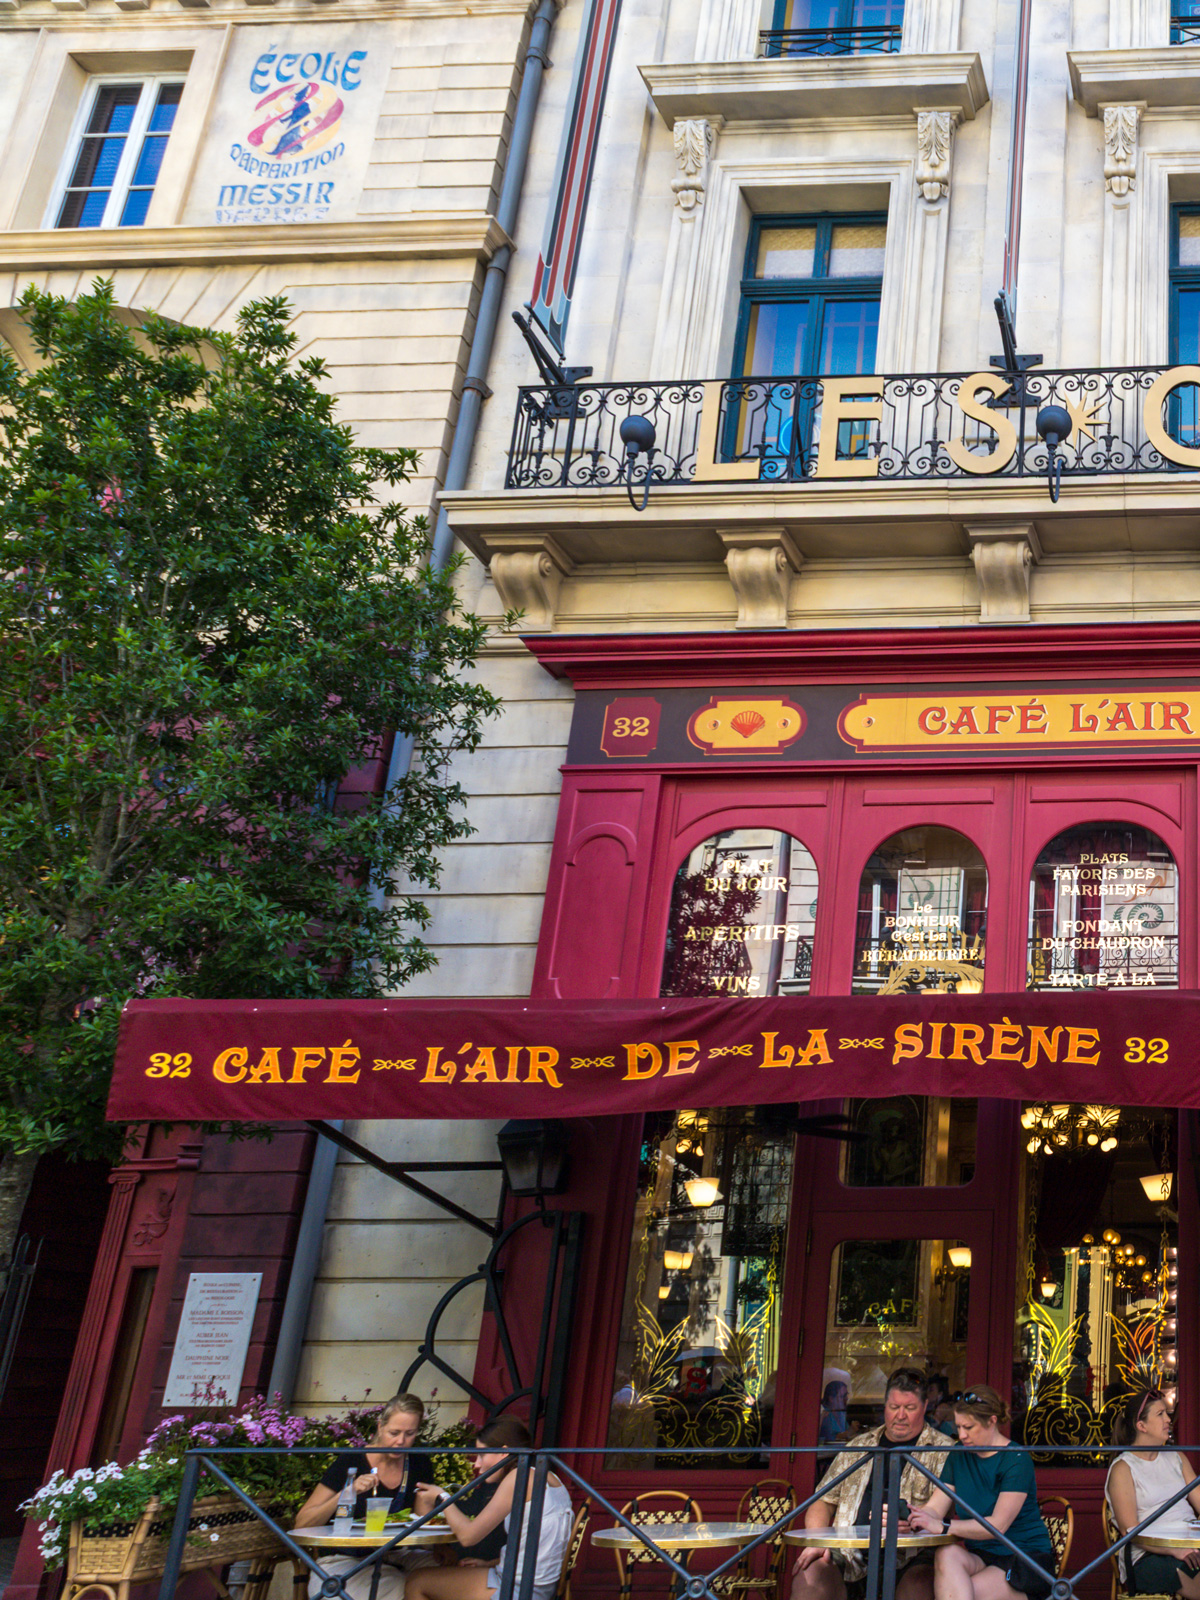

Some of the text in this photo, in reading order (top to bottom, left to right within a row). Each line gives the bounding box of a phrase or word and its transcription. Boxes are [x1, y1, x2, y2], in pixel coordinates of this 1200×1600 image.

[250, 44, 368, 94] ÉCOLE
[690, 373, 1018, 482] LES
[918, 698, 1048, 736] CAFÉ
[1069, 699, 1196, 736] L'AIR
[612, 716, 650, 738] 32
[722, 859, 773, 874] PLAT
[1080, 853, 1129, 865] PLATS
[1052, 868, 1155, 881] FAVORIS DES
[704, 876, 788, 892] DU JOUR
[1060, 884, 1147, 897] PARISIENS
[913, 902, 932, 913] Le
[885, 915, 960, 929] BONHEUR
[1062, 920, 1145, 934] FONDANT
[683, 924, 800, 943] APÉRITIFS
[928, 930, 947, 941] La
[1042, 936, 1165, 951] DU CHAUDRON
[712, 976, 760, 993] VINS
[1048, 971, 1156, 988] TARTE À LA
[145, 1017, 1170, 1088] 32 CAFÉ L'AIR DE LA SIRÈNE 32
